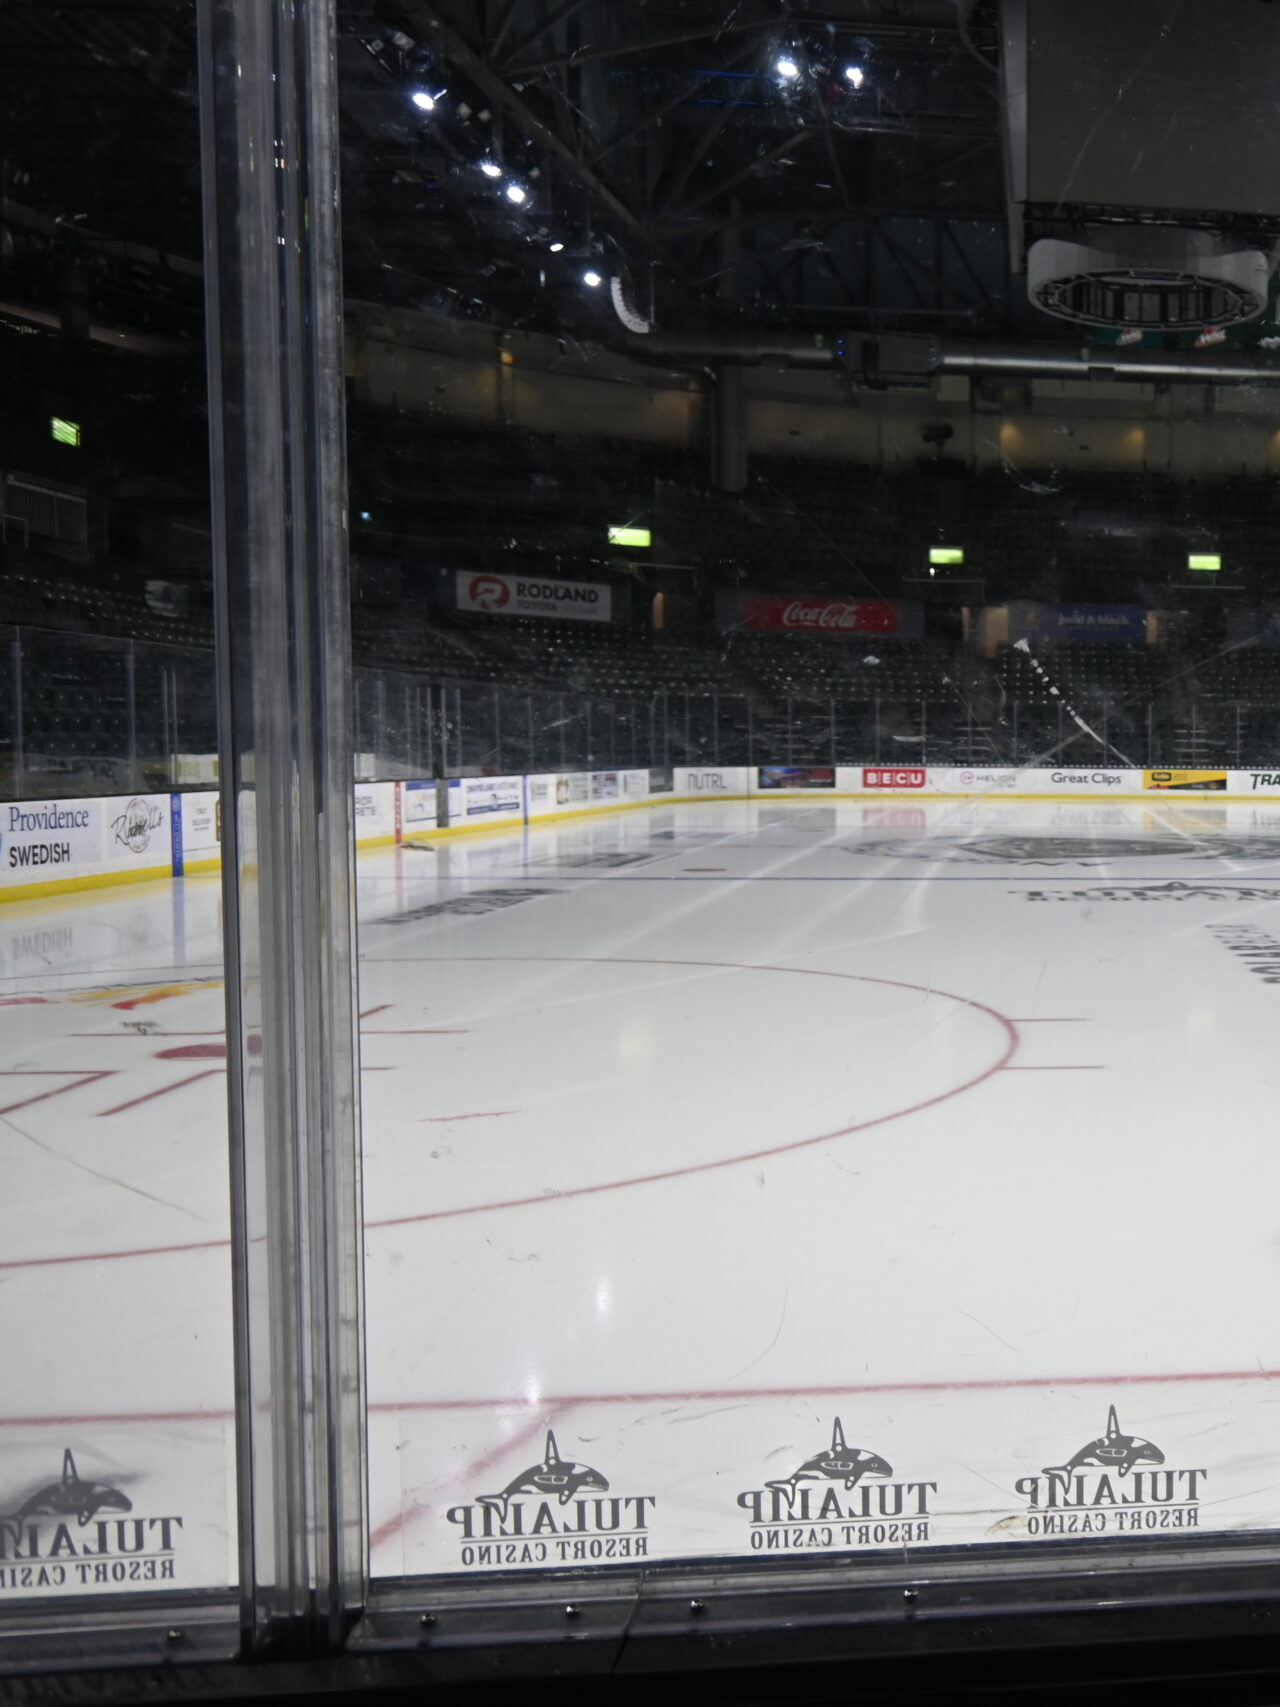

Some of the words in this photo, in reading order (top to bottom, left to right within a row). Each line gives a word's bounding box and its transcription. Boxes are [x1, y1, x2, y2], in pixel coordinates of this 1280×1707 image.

[516, 583, 599, 603] RODLAND
[866, 772, 923, 784] BECU
[1051, 772, 1089, 784] Great
[1091, 772, 1122, 786] Clips
[8, 803, 89, 832] Providence
[9, 842, 70, 868] SWEDISH
